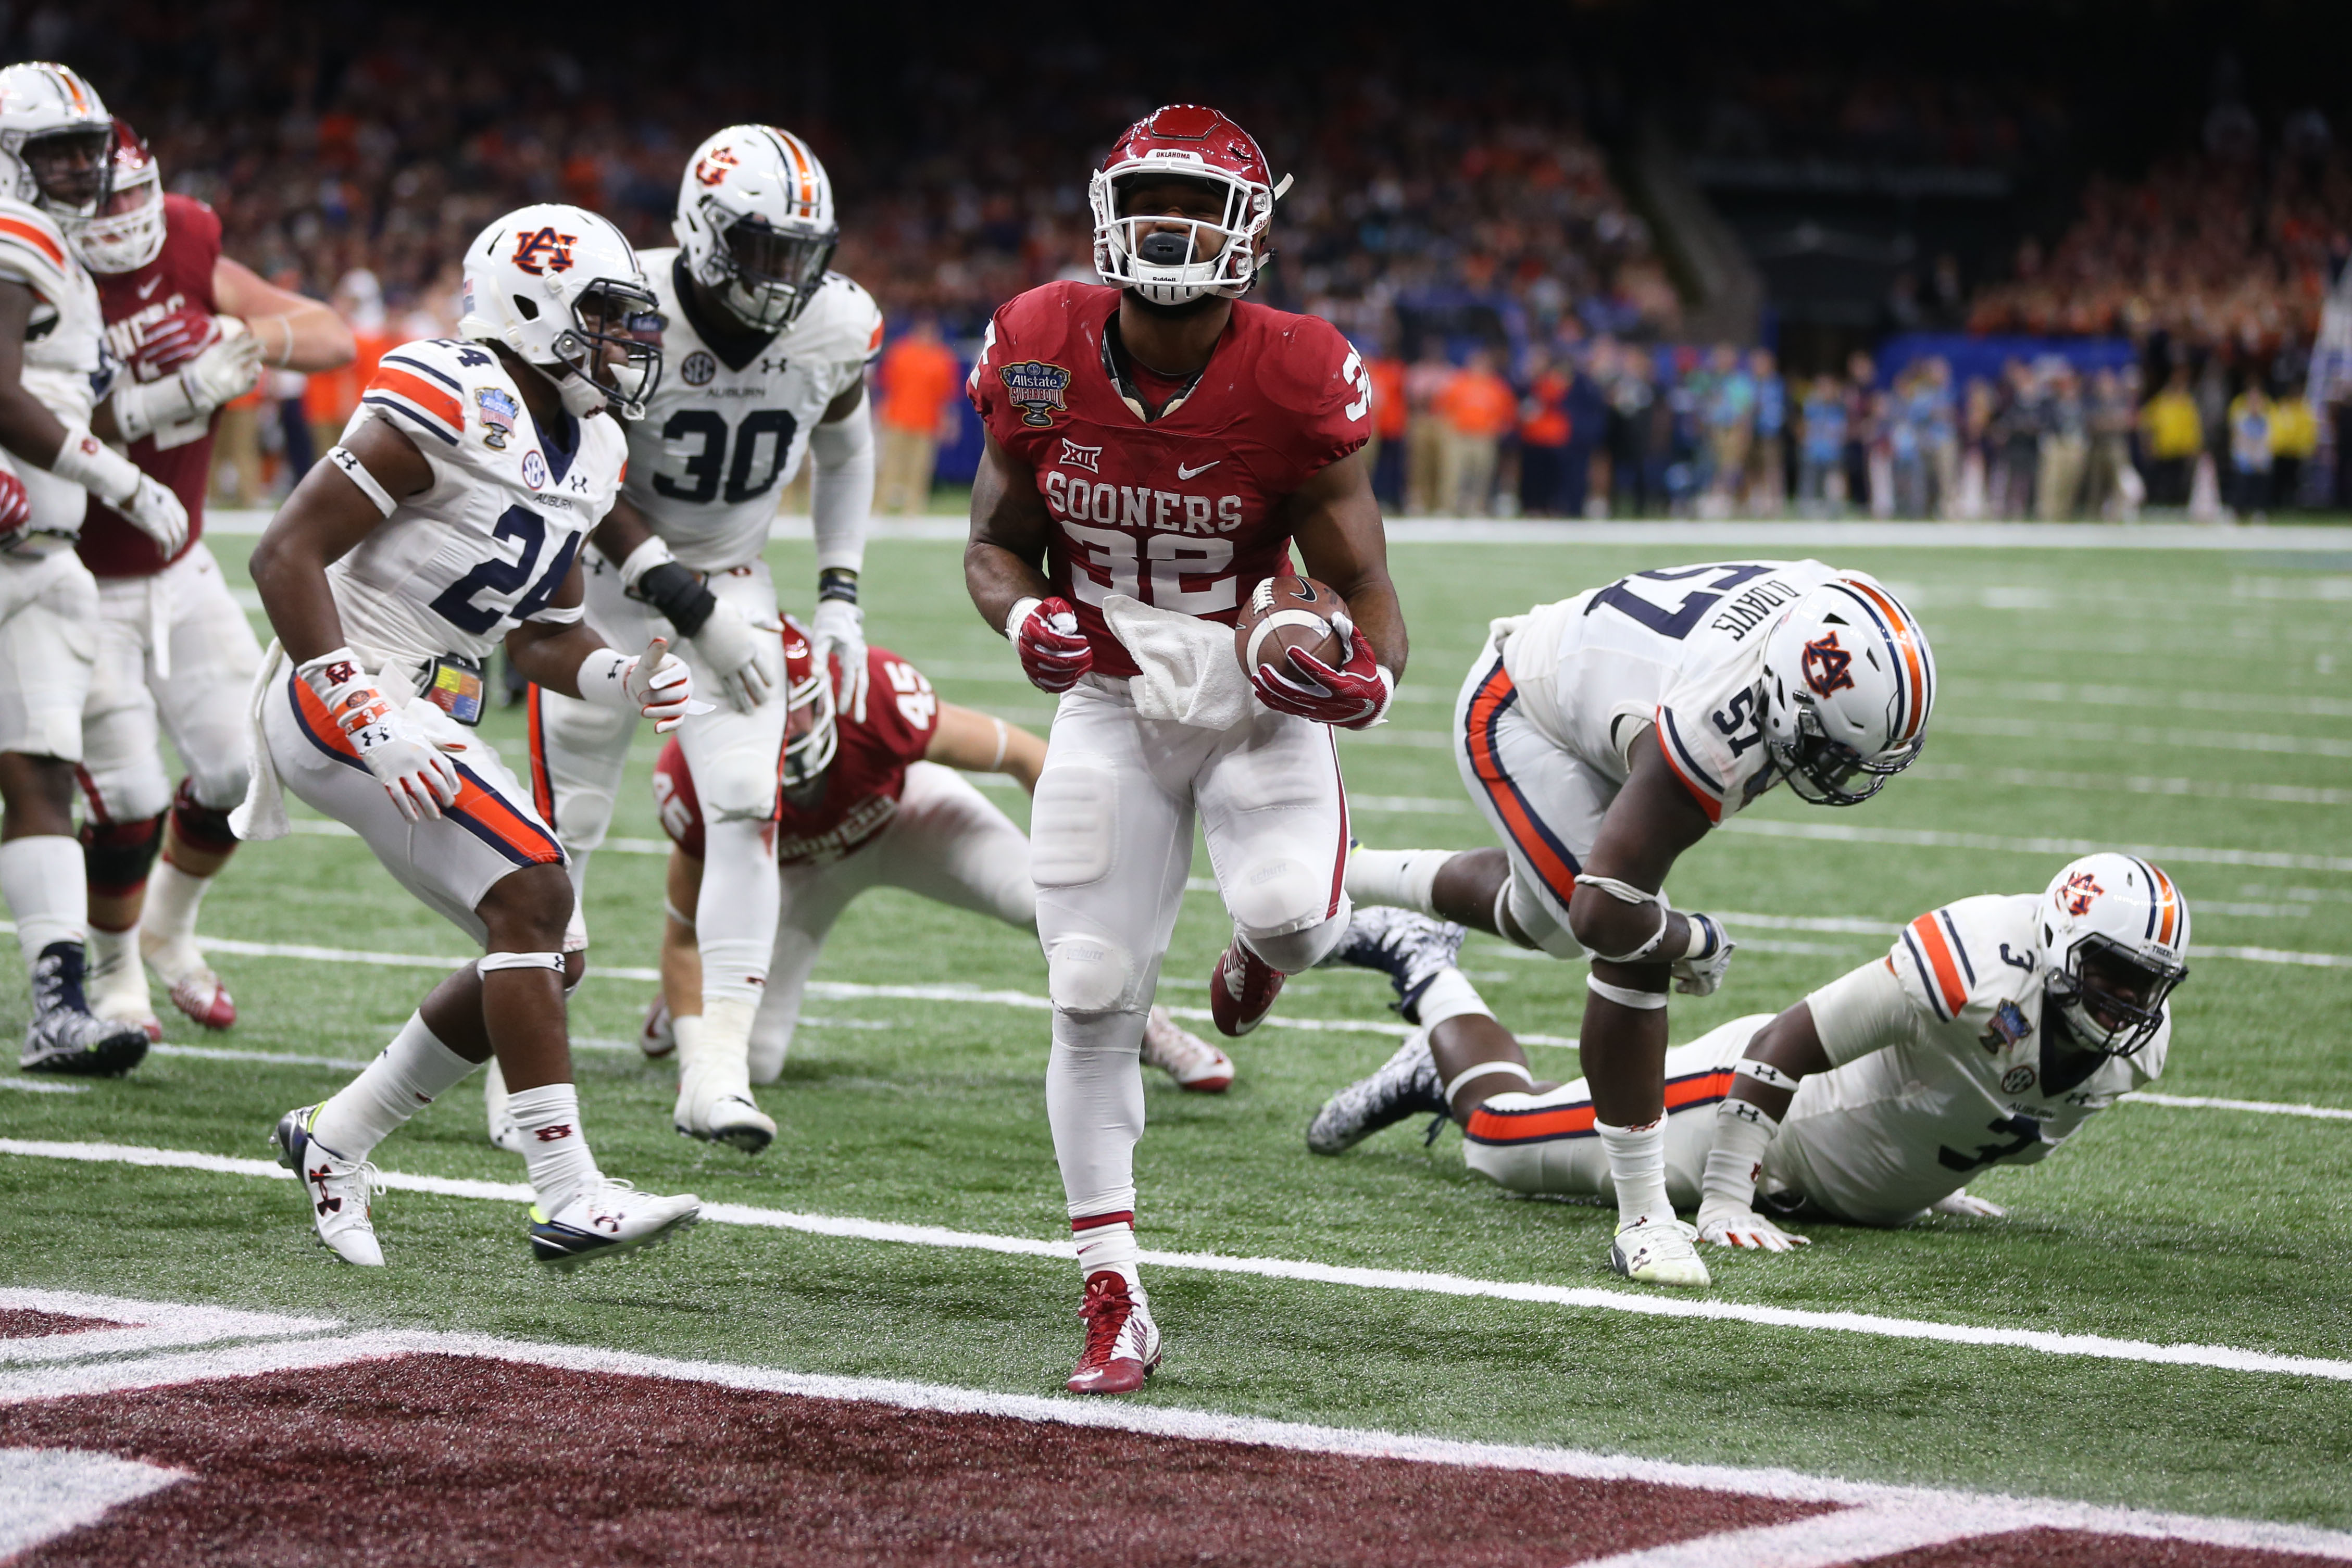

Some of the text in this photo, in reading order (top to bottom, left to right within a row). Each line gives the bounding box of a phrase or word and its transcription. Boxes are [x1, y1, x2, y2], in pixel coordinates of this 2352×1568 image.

[683, 353, 714, 384] SEC
[706, 387, 766, 398] AUBURN
[1011, 374, 1057, 388] Allstate
[1342, 340, 1372, 422] 3
[523, 452, 545, 488] SEC
[653, 409, 797, 504] 30
[534, 493, 575, 510] AUBURN
[1046, 470, 1242, 534] SOONERS
[429, 504, 582, 635] 24
[1060, 520, 1237, 616] 32
[884, 661, 937, 730] 45
[1999, 943, 2035, 973] 3
